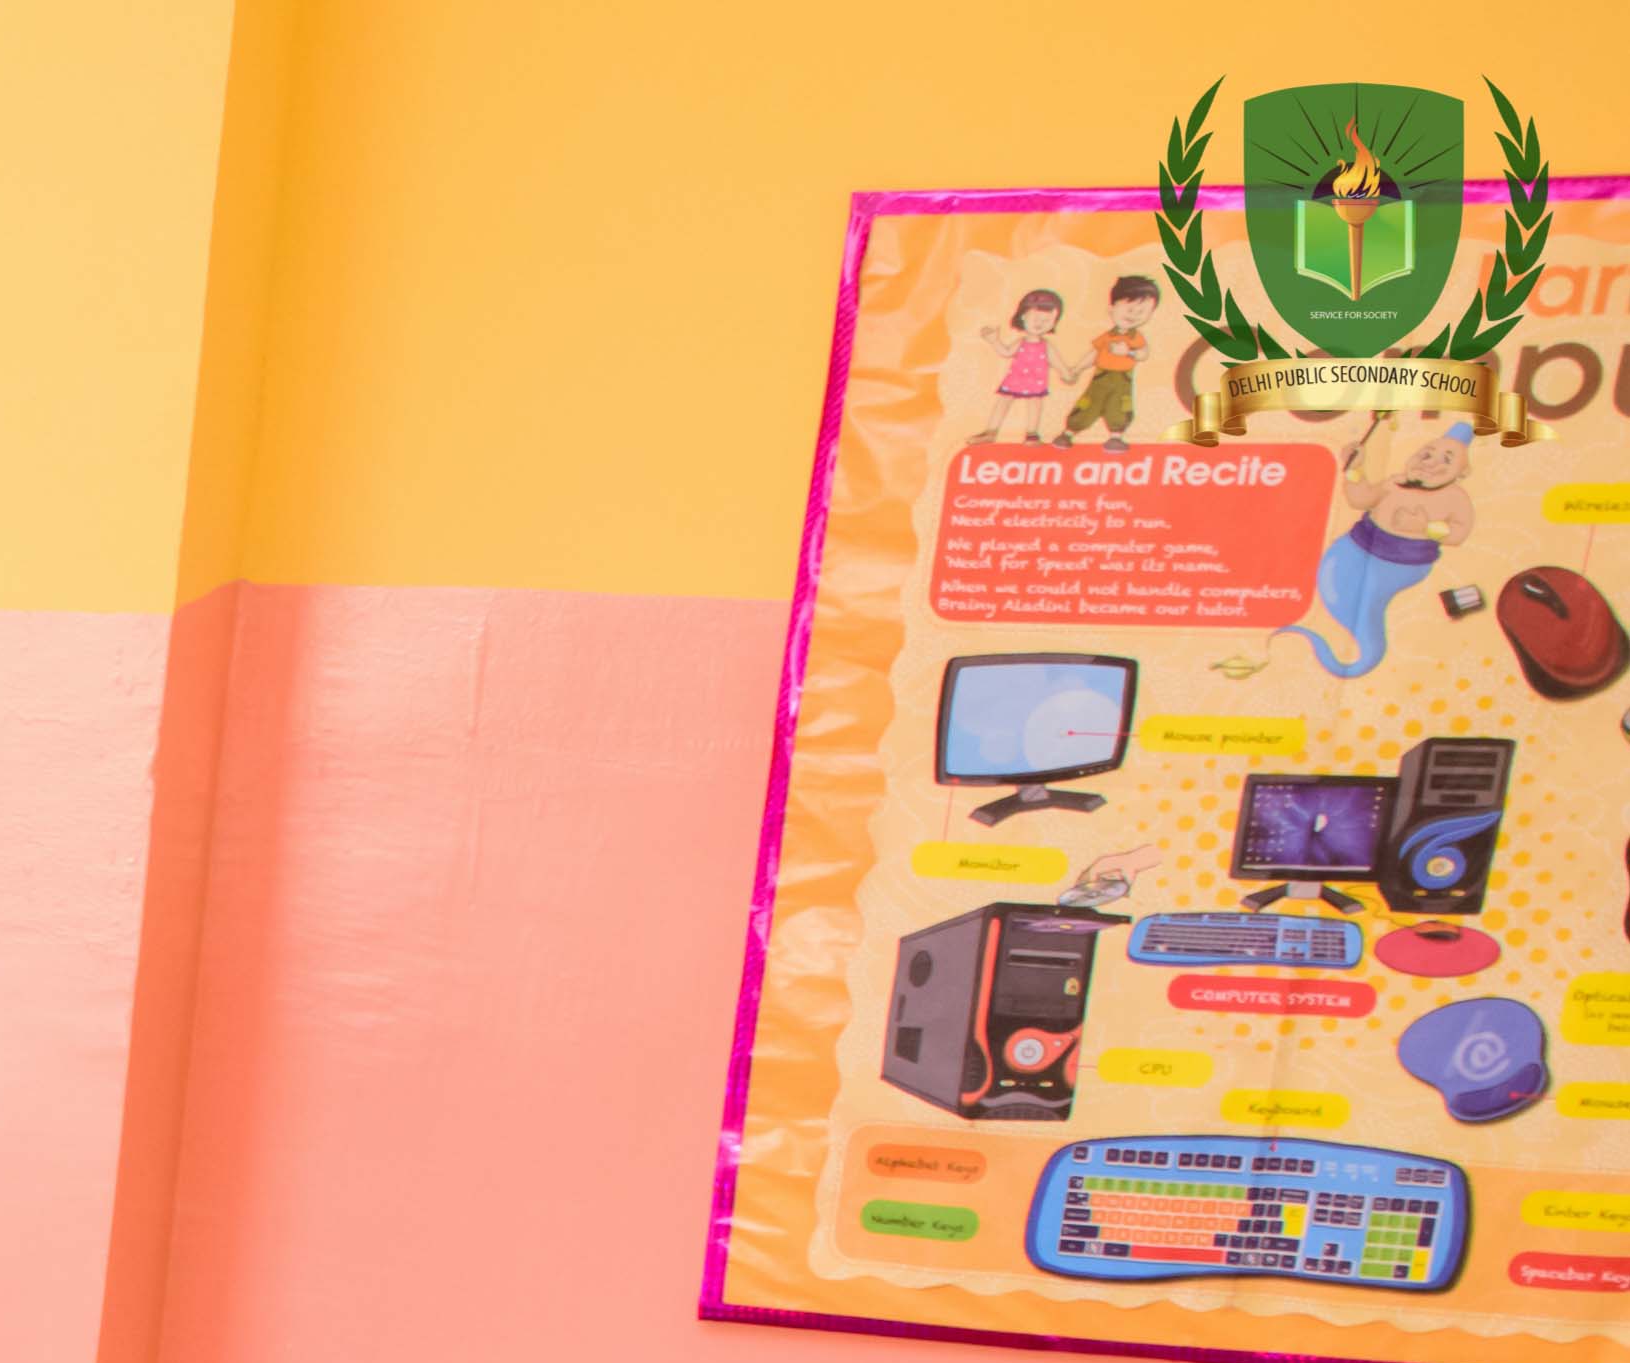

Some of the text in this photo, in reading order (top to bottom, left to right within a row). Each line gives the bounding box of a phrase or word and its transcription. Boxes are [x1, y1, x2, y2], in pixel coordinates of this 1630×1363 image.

[959, 455, 1287, 486] Learn and Recite
[954, 494, 1133, 514] Computers are fun,
[951, 514, 995, 528] Need
[1002, 514, 1099, 535] electricity
[1106, 515, 1126, 529] to
[947, 538, 973, 551] We
[979, 538, 1041, 558] played
[1048, 542, 1060, 553] a
[1068, 541, 1156, 561] computer
[1000, 556, 1029, 574] for
[1099, 560, 1134, 573] was
[1141, 558, 1165, 573] its
[940, 579, 987, 594] When
[995, 583, 1018, 595] we
[1026, 581, 1080, 596] could
[1088, 581, 1119, 597] not
[1126, 581, 1193, 598] handle
[937, 598, 997, 618] Brainy
[1078, 598, 1147, 616] became
[1155, 602, 1189, 616] our
[1191, 988, 1352, 1008] COMPUTER SYSTEM
[1139, 1062, 1173, 1077] CPU
